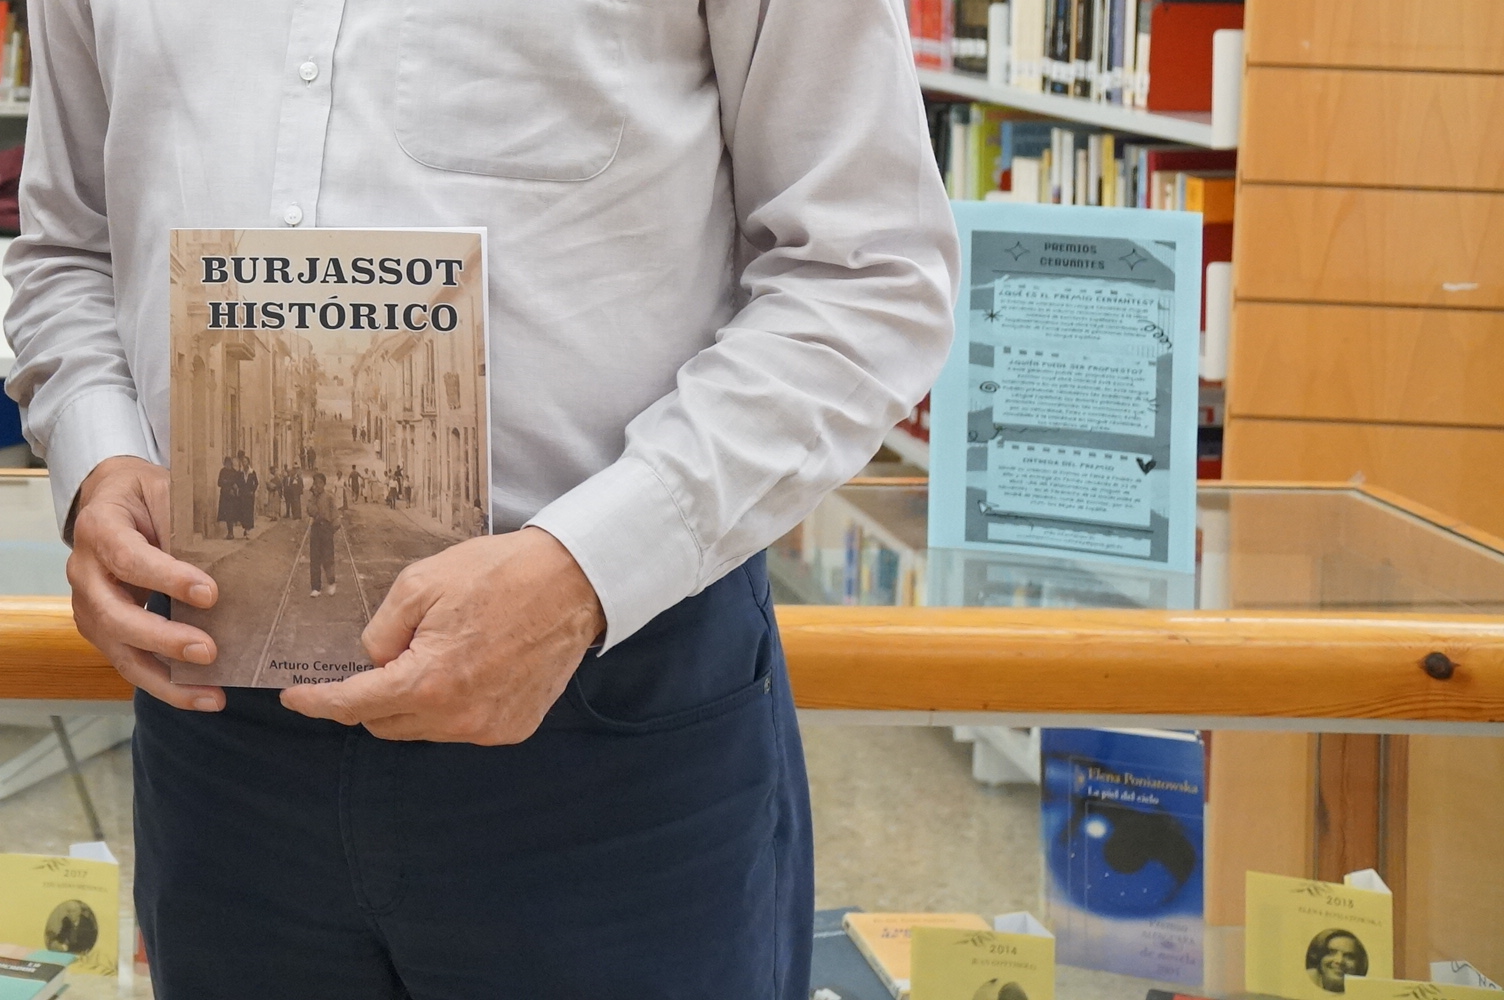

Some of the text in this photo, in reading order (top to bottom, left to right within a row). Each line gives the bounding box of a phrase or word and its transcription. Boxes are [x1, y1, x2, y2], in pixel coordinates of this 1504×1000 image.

[1044, 242, 1097, 254] PREMIOS
[1040, 258, 1105, 270] CERVANTES
[201, 256, 463, 287] BURJASSOT
[208, 295, 458, 332] HISTÓRICO
[269, 660, 375, 672] Arturo Cervellera
[292, 675, 350, 684] Moscard
[1088, 766, 1198, 794] Elena Poniatowska
[1088, 786, 1160, 805] La piel del cielo
[64, 869, 88, 878] 2017
[990, 944, 1016, 956] 2014
